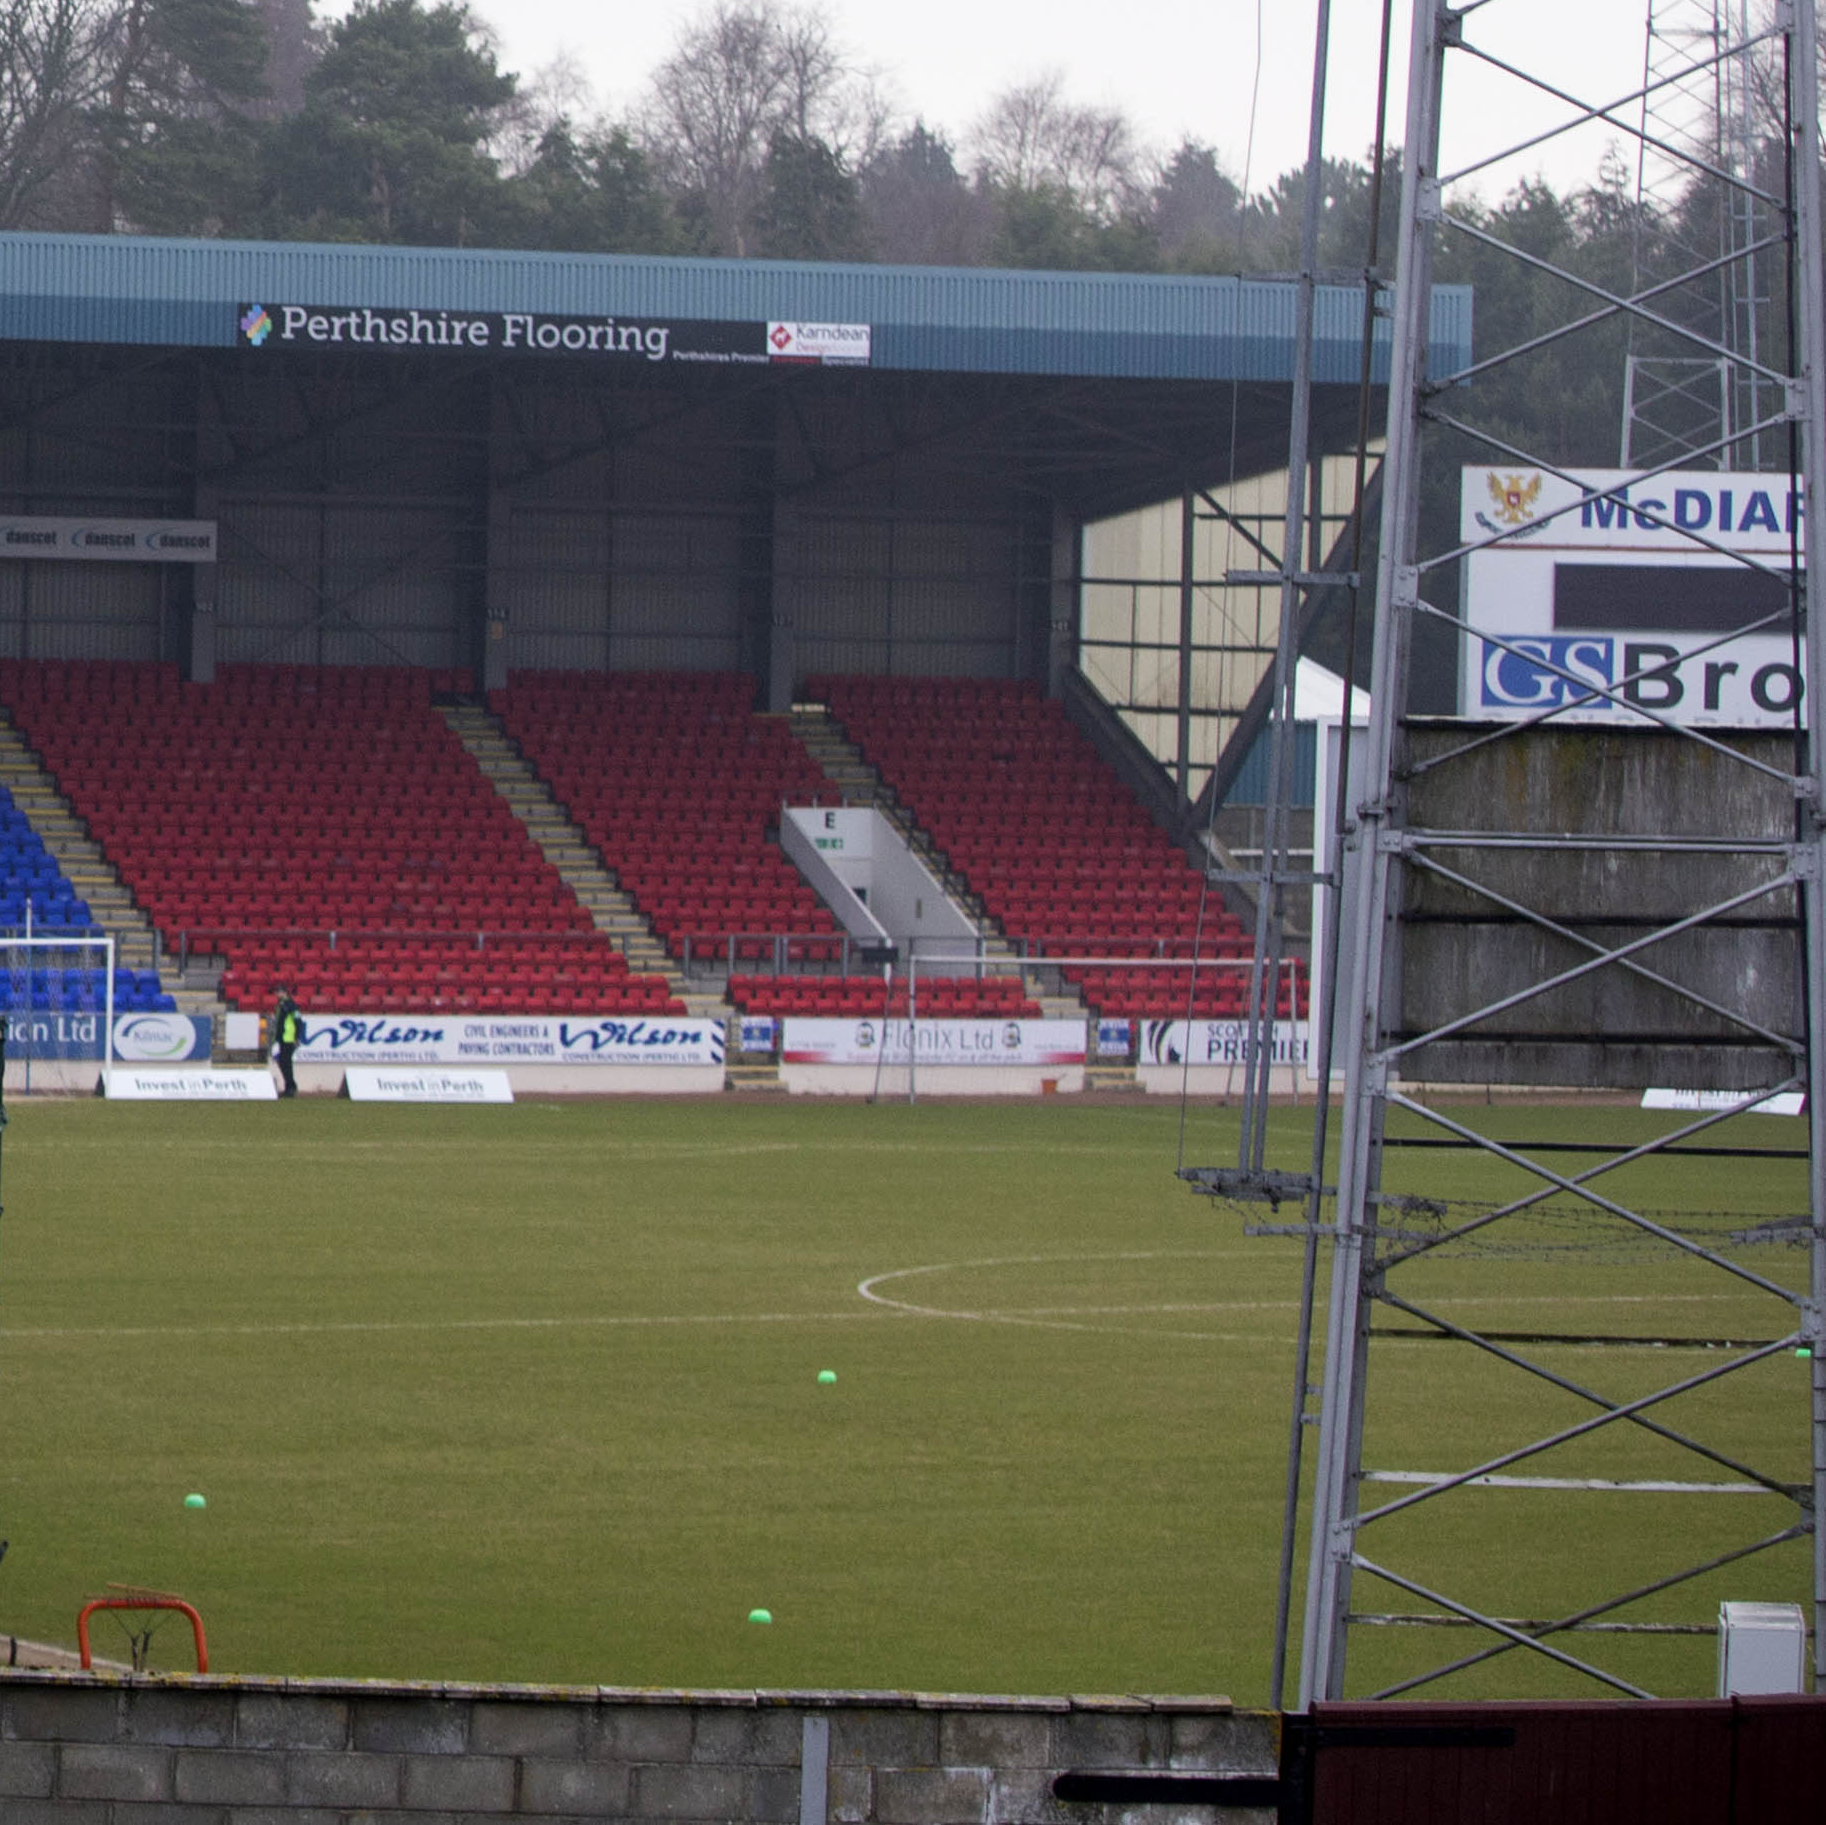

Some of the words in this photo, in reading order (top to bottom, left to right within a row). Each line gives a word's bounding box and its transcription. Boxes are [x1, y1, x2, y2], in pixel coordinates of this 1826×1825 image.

[281, 305, 490, 346] Perthshire
[502, 313, 669, 361] Flooring
[797, 324, 870, 342] Karndean
[1484, 638, 1608, 706] GS
[824, 811, 836, 830] E
[58, 1016, 96, 1043] Ltd
[132, 1027, 173, 1043] Kilmac
[298, 1019, 444, 1048] Wilson
[464, 1023, 488, 1038] CIVIL
[490, 1023, 541, 1038] ENGINEERS
[559, 1021, 702, 1051] Wilson
[960, 1027, 994, 1051] Ltd
[458, 1041, 490, 1056] PAVING
[492, 1041, 555, 1057] CONTRACTORS
[562, 1052, 640, 1062] CONSTRUCTION
[135, 1078, 185, 1092] Invest
[187, 1078, 202, 1092] in
[203, 1078, 247, 1092] Perth
[377, 1078, 425, 1092] Invest
[427, 1078, 441, 1092] in
[441, 1078, 484, 1093] Perth
